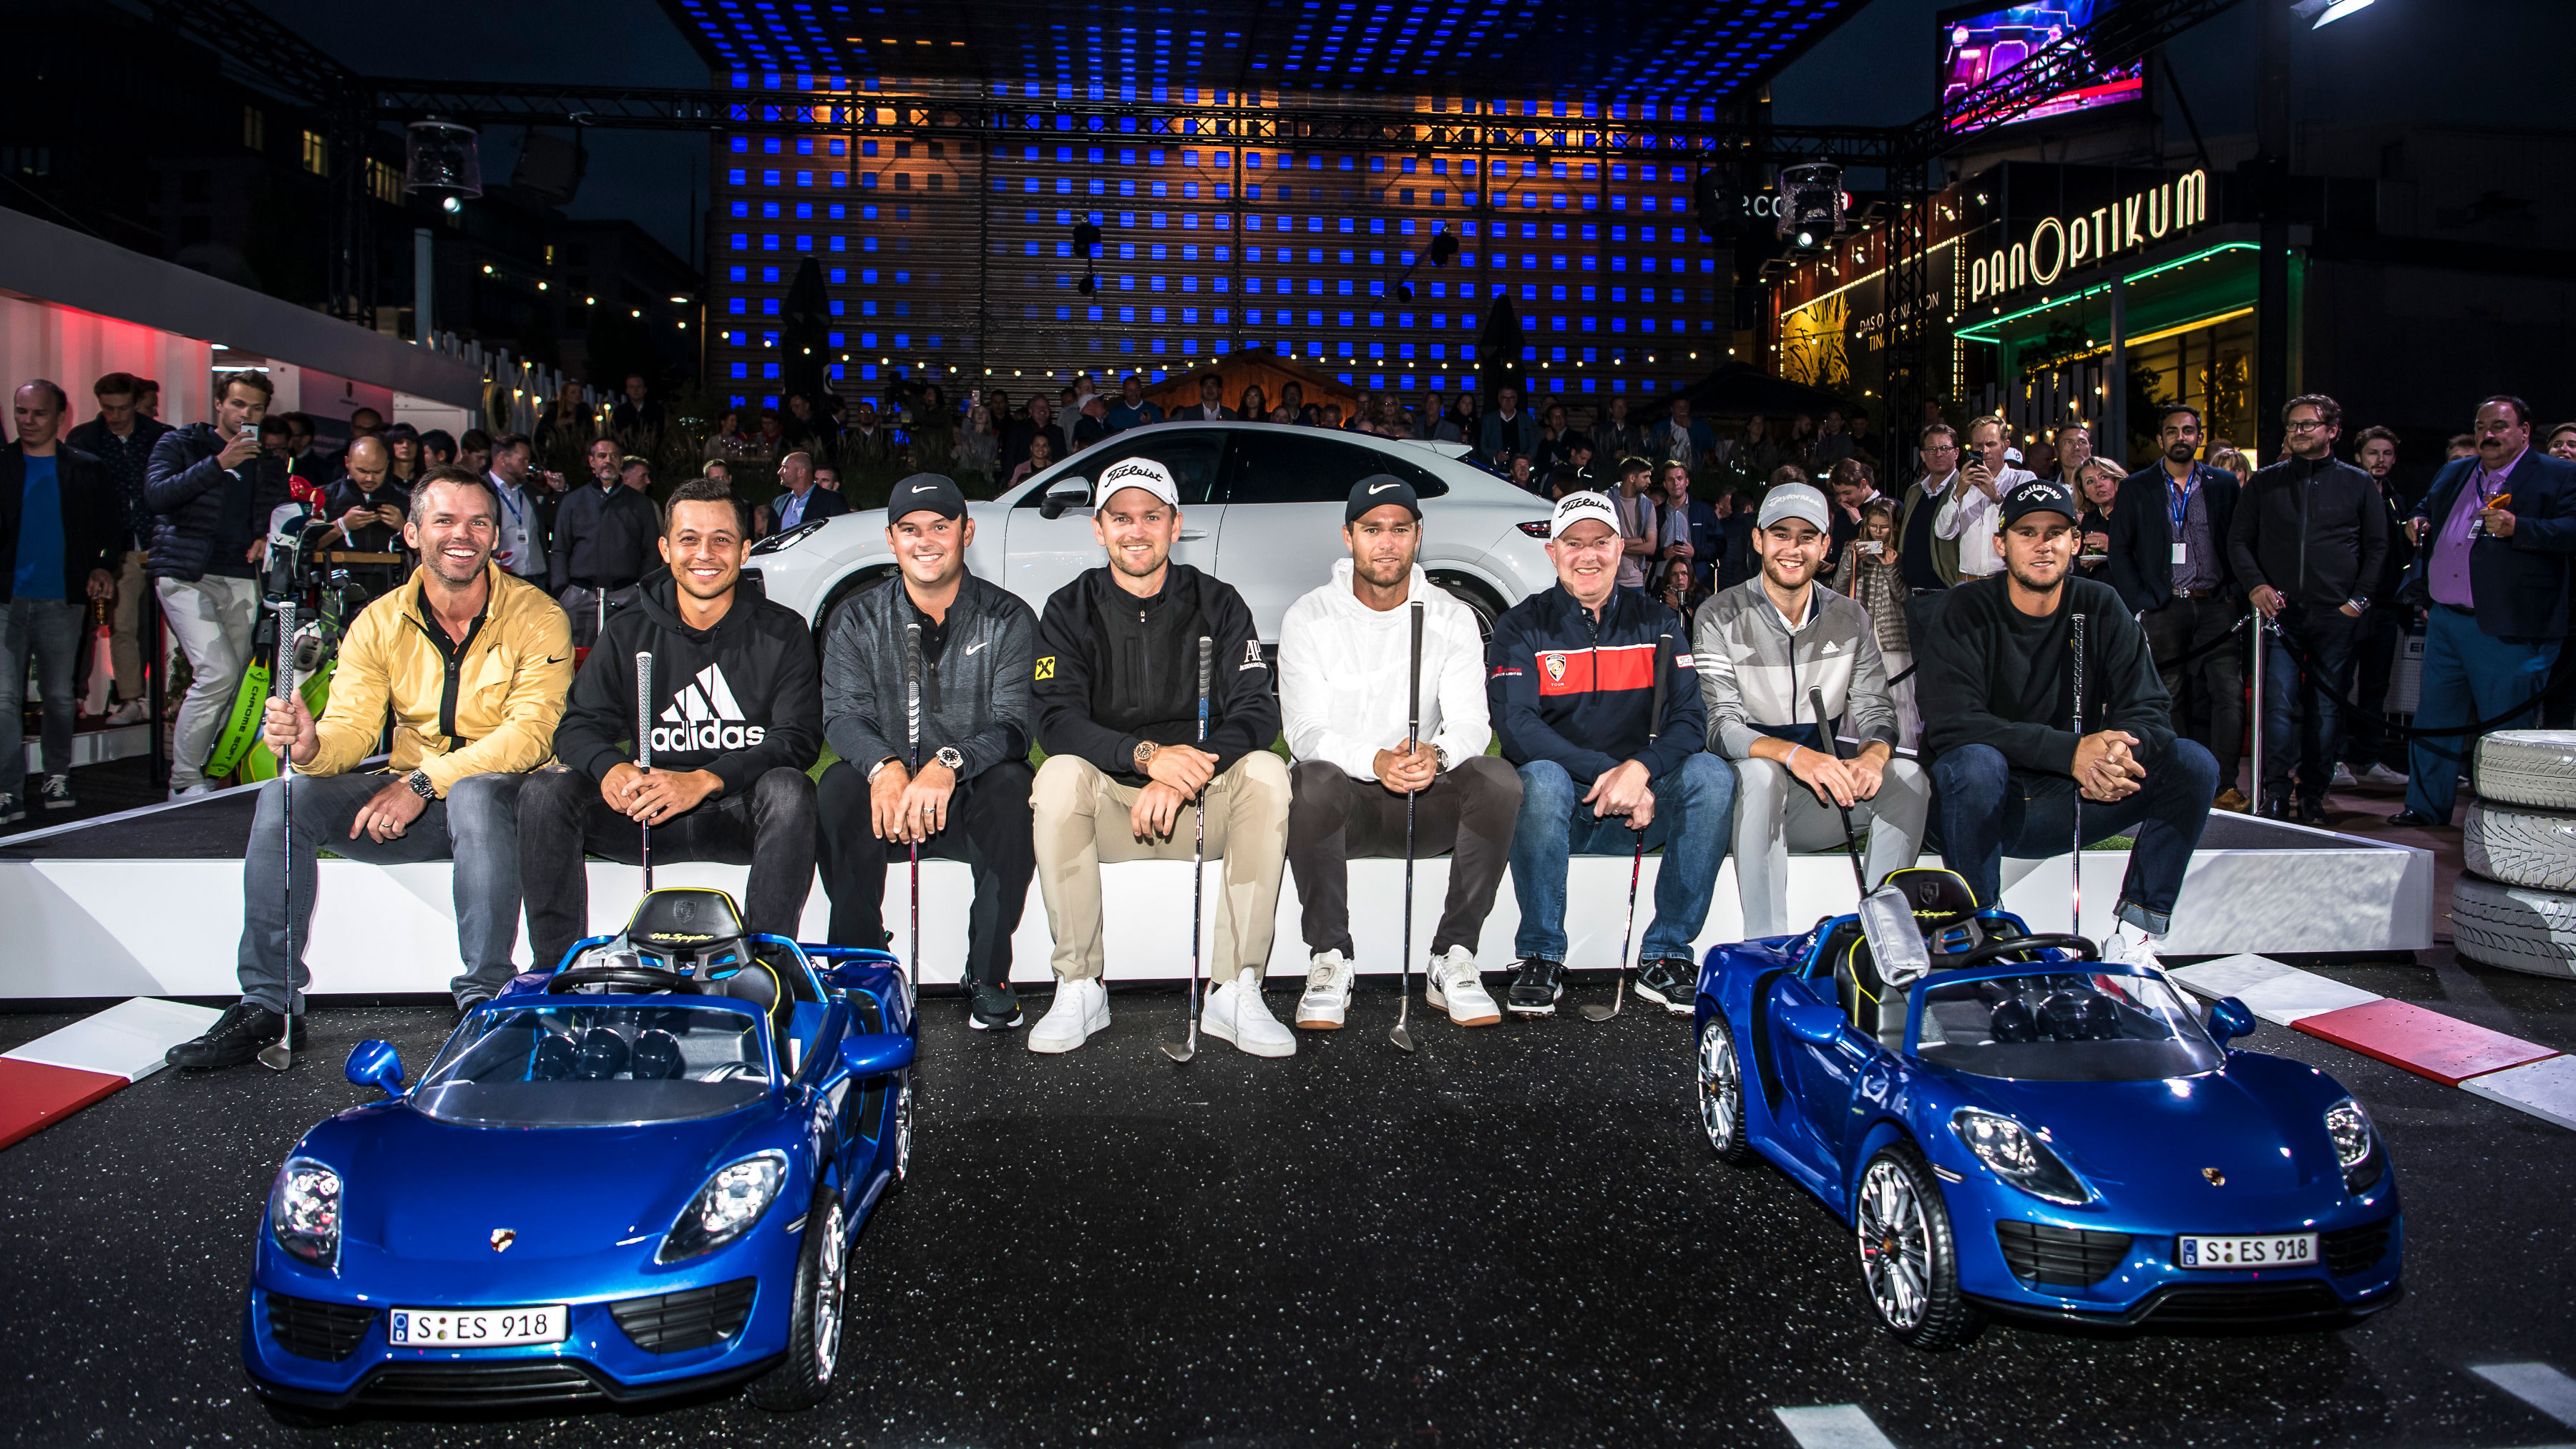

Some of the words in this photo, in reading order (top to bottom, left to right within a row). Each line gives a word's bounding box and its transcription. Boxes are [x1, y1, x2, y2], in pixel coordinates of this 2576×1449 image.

[1860, 316, 1875, 333] DAS
[1104, 464, 1163, 488] Titleist
[1767, 494, 1823, 508] TaylorMade
[2017, 484, 2062, 501] Callaway
[1558, 497, 1611, 518] Titleist
[1244, 640, 1262, 663] AP
[1820, 646, 1840, 655] adidas
[238, 686, 259, 733] CHROME
[650, 718, 766, 751] adidas
[225, 736, 243, 761] SOFT
[1918, 909, 1957, 919] Spyder
[670, 932, 713, 943] Spyder
[2206, 1241, 2219, 1262] S
[2240, 1241, 2265, 1262] ES
[2275, 1238, 2308, 1261] 918
[417, 1317, 431, 1339] S
[457, 1317, 487, 1339] ES
[502, 1314, 547, 1337] 918
